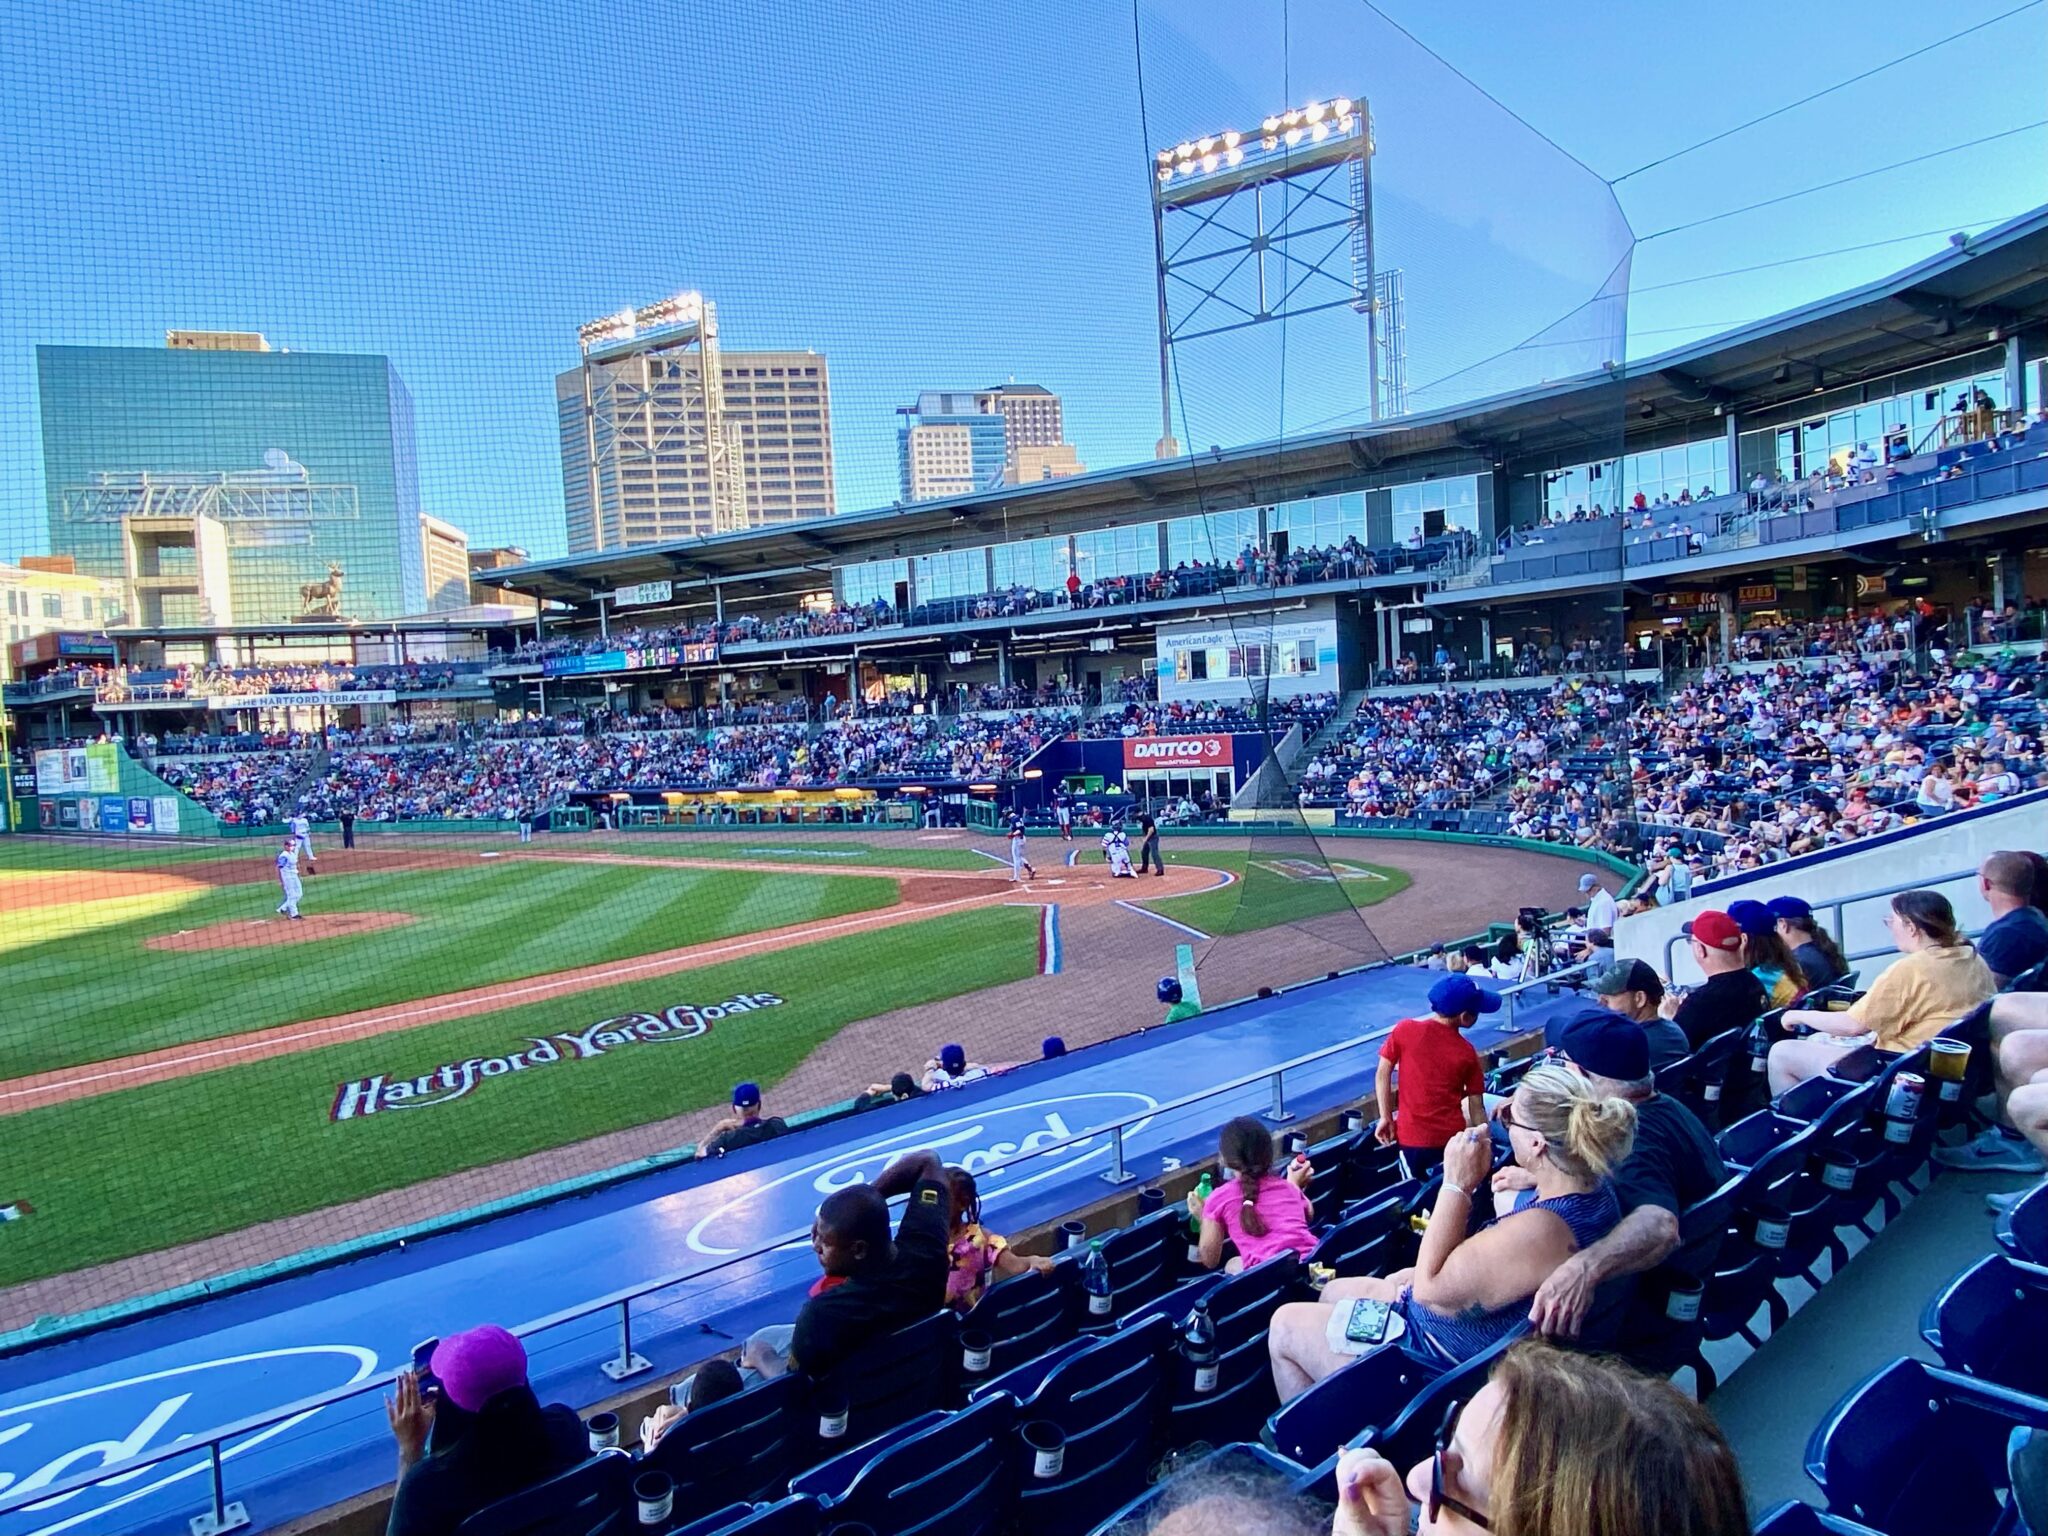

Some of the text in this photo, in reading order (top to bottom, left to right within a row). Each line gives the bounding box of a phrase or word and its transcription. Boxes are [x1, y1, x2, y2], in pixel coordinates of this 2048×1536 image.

[638, 582, 670, 593] PARTY
[1165, 635, 1202, 648] American
[1203, 633, 1225, 646] Eagle
[236, 693, 369, 707] THE HARTFORD TERRACE
[1133, 740, 1203, 758] DATTCO
[329, 992, 788, 1122] Hartford Yard Goats
